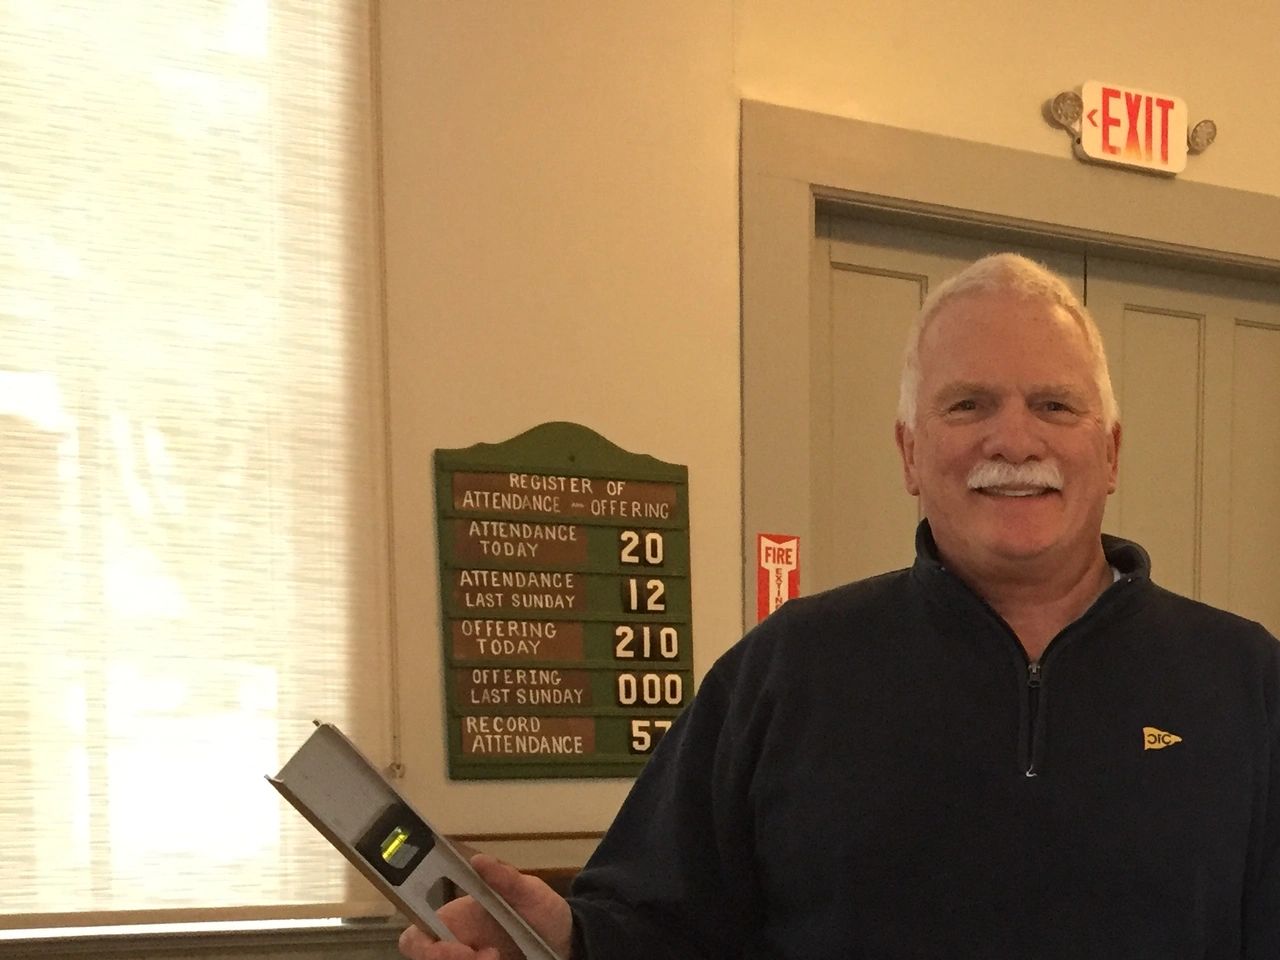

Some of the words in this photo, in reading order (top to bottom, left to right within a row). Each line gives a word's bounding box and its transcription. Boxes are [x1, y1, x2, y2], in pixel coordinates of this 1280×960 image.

[1102, 87, 1174, 165] EXIT
[509, 473, 593, 494] REGISTER
[607, 481, 626, 496] OF
[462, 491, 561, 513] ATTENDANCE
[591, 500, 669, 519] OFFERING
[469, 521, 577, 542] ATTENDANCE
[479, 541, 539, 558] TODAY
[620, 531, 664, 564] 20
[765, 546, 793, 565] FIRE
[460, 571, 574, 588] ATTENDANCE
[465, 593, 504, 608] LAST
[511, 594, 576, 609] SUNDAY
[628, 579, 665, 611] 12
[462, 621, 557, 639] OFFERING
[477, 639, 541, 655] TODAY
[615, 626, 678, 659] 210
[472, 670, 562, 685] OFFERING
[471, 689, 514, 704] LAST
[516, 689, 583, 705] SUNDAY
[618, 673, 682, 705] 000
[466, 717, 541, 733] RECORD
[472, 735, 583, 754] ATTENDANCE
